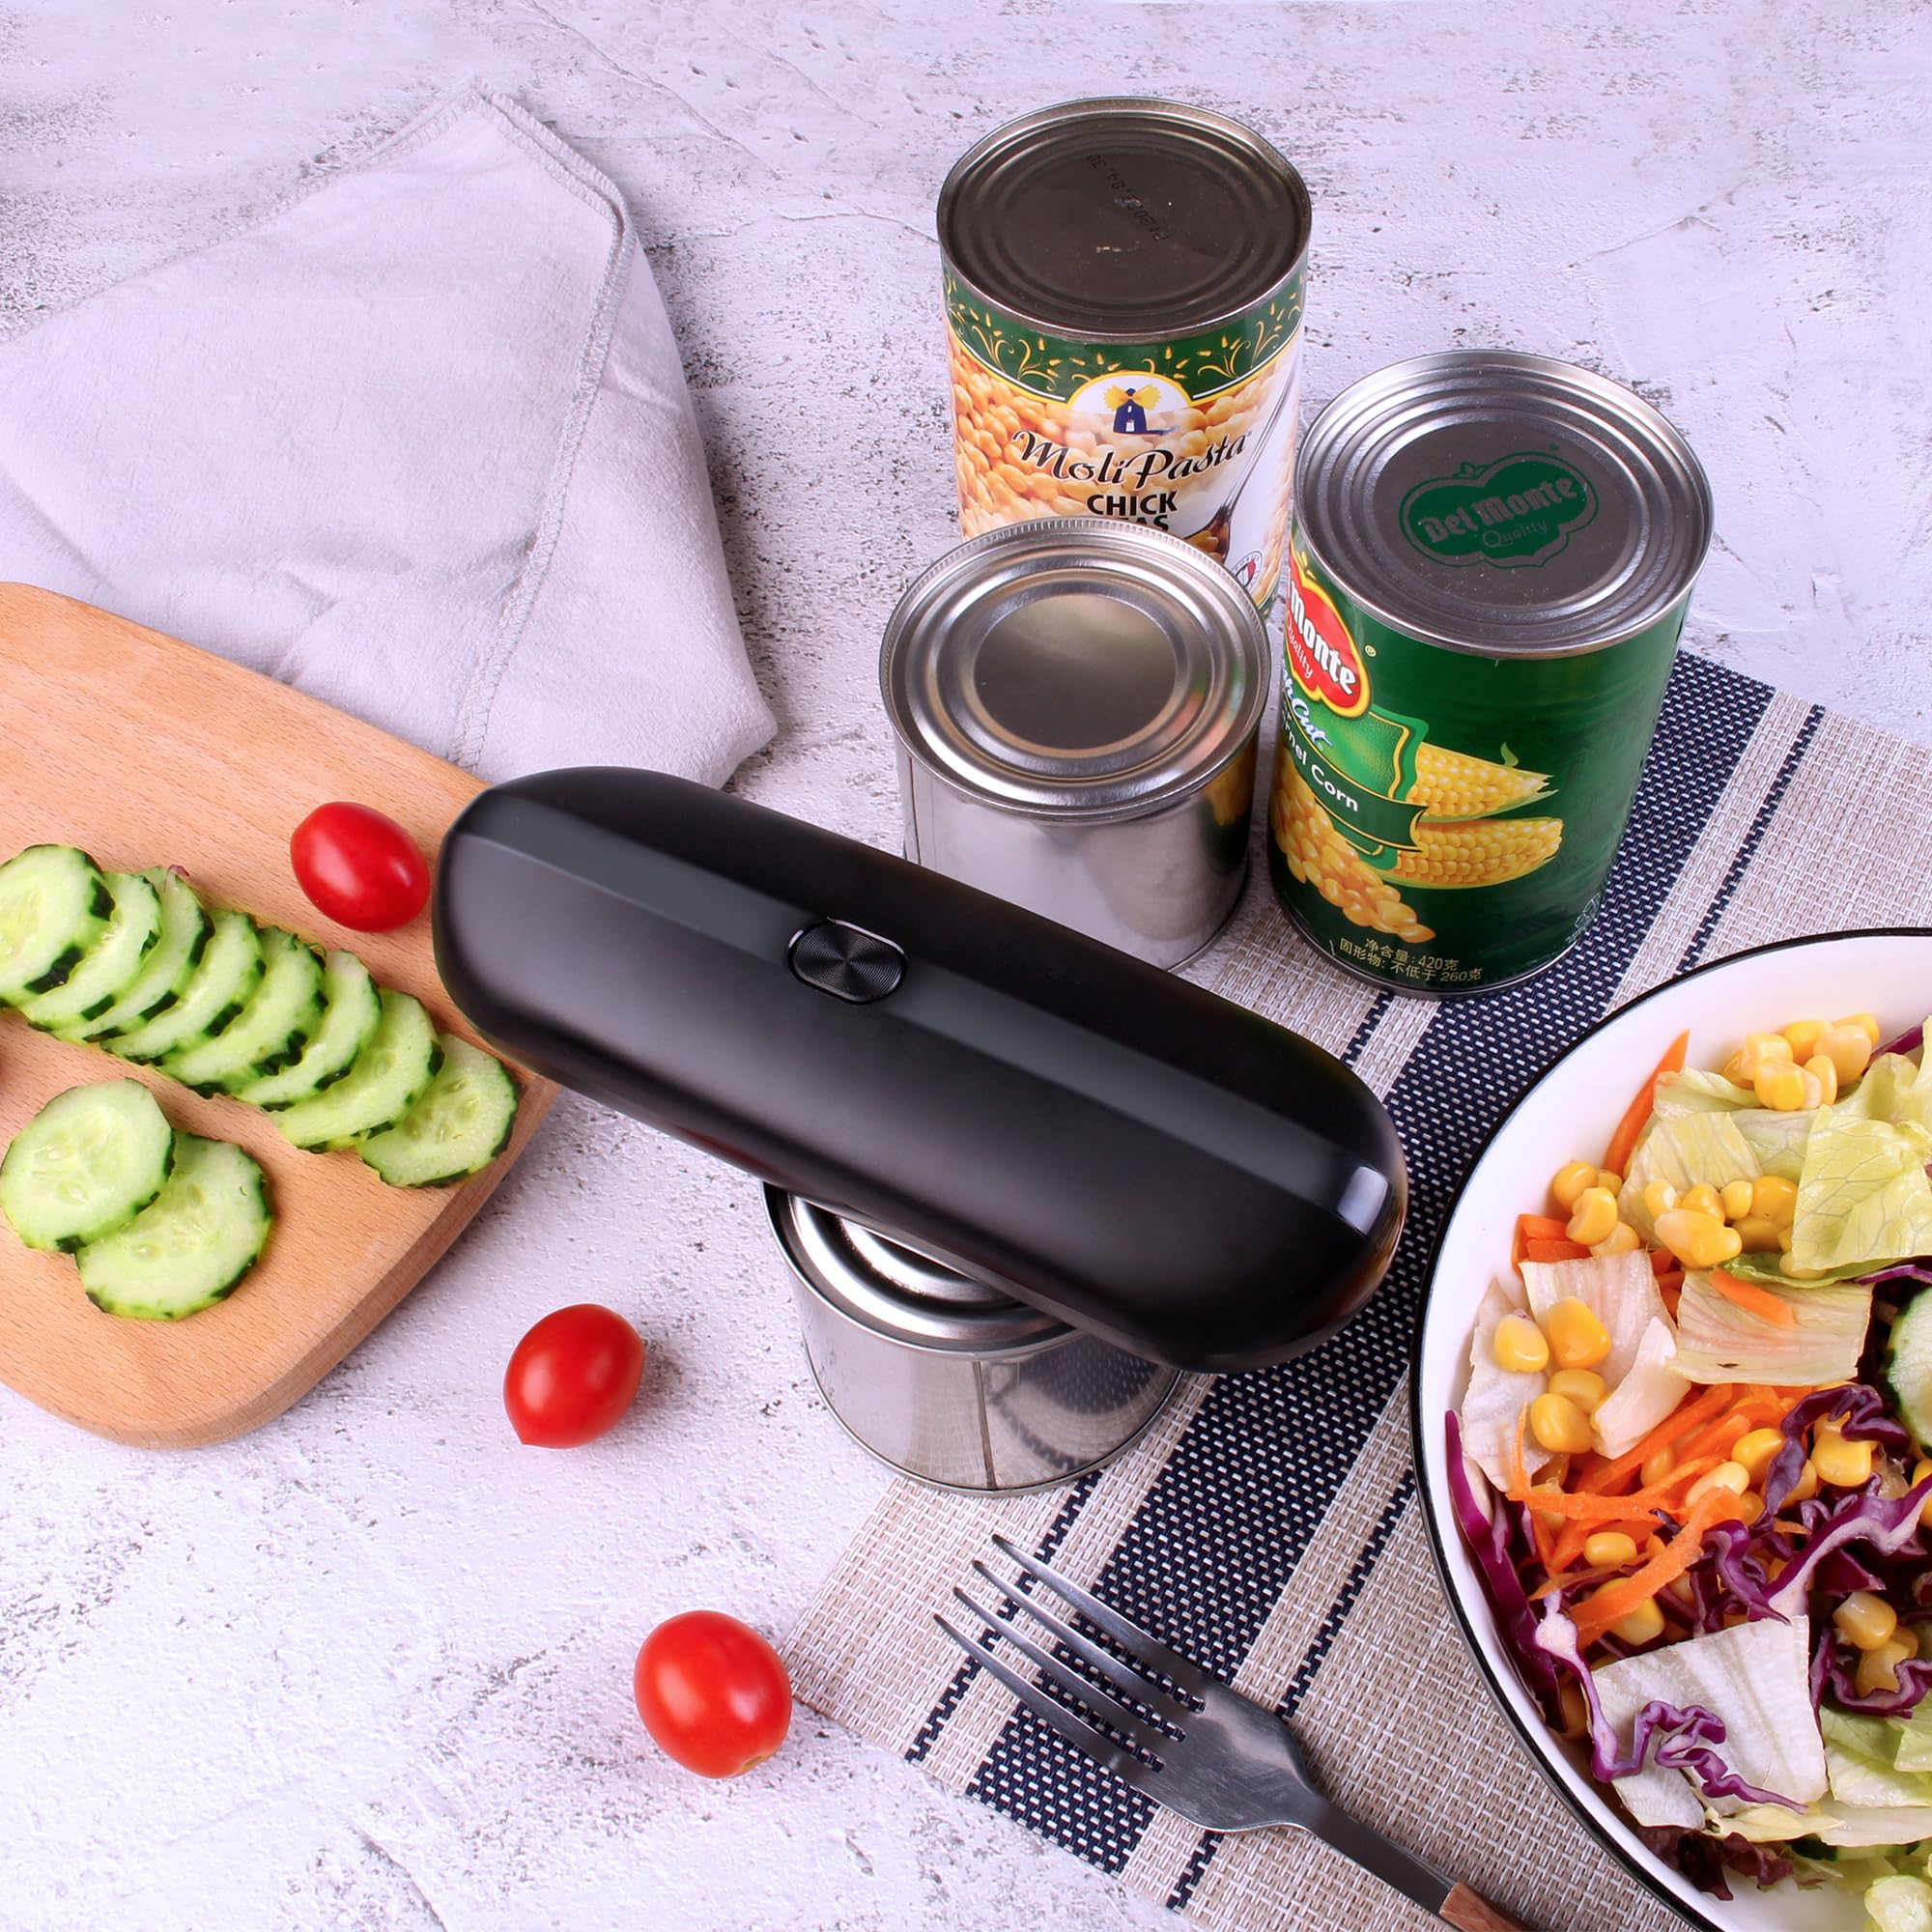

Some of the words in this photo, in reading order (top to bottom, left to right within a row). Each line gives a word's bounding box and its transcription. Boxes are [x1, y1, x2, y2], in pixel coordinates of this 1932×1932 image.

[1012, 430, 1125, 485] Moli
[1124, 434, 1247, 490] Pasta
[1087, 491, 1178, 516] CHICK
[1417, 506, 1478, 543] Del
[1470, 478, 1577, 526] Monte
[1482, 520, 1548, 548] Quality
[1291, 581, 1356, 696] Monte
[1292, 697, 1333, 747] Cut
[1311, 764, 1358, 812] Corn
